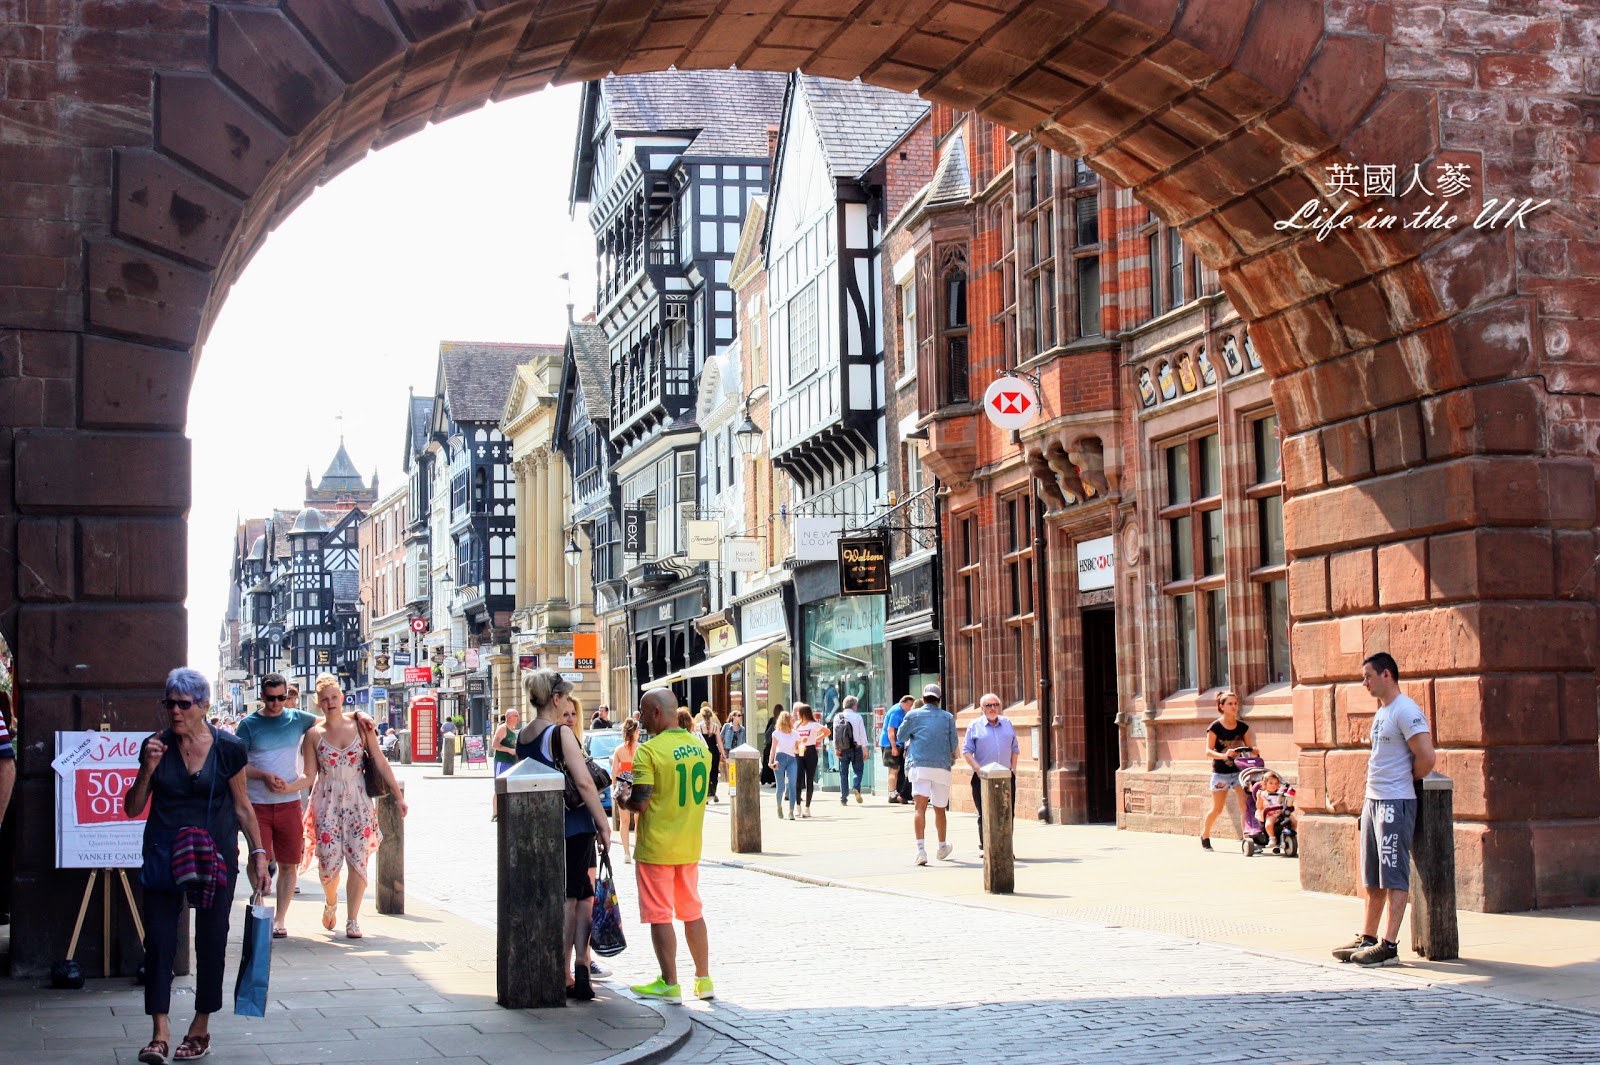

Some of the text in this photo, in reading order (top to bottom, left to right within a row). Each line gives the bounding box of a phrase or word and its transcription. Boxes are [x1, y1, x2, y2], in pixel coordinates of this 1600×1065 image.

[627, 515, 639, 549] next
[803, 531, 831, 539] NEW
[801, 538, 834, 546] LOOK
[843, 549, 884, 563] Waltons
[1079, 557, 1097, 573] HSBC
[836, 608, 881, 634] NEW LOOK
[60, 738, 92, 766] NEW LINES
[72, 748, 92, 767] ADDED
[89, 735, 140, 762] Sale
[673, 744, 705, 761] BRASIL
[675, 761, 707, 807] 10
[91, 796, 124, 815] OF
[78, 853, 143, 861] YANKEE CAND
[1391, 833, 1399, 868] RETRO
